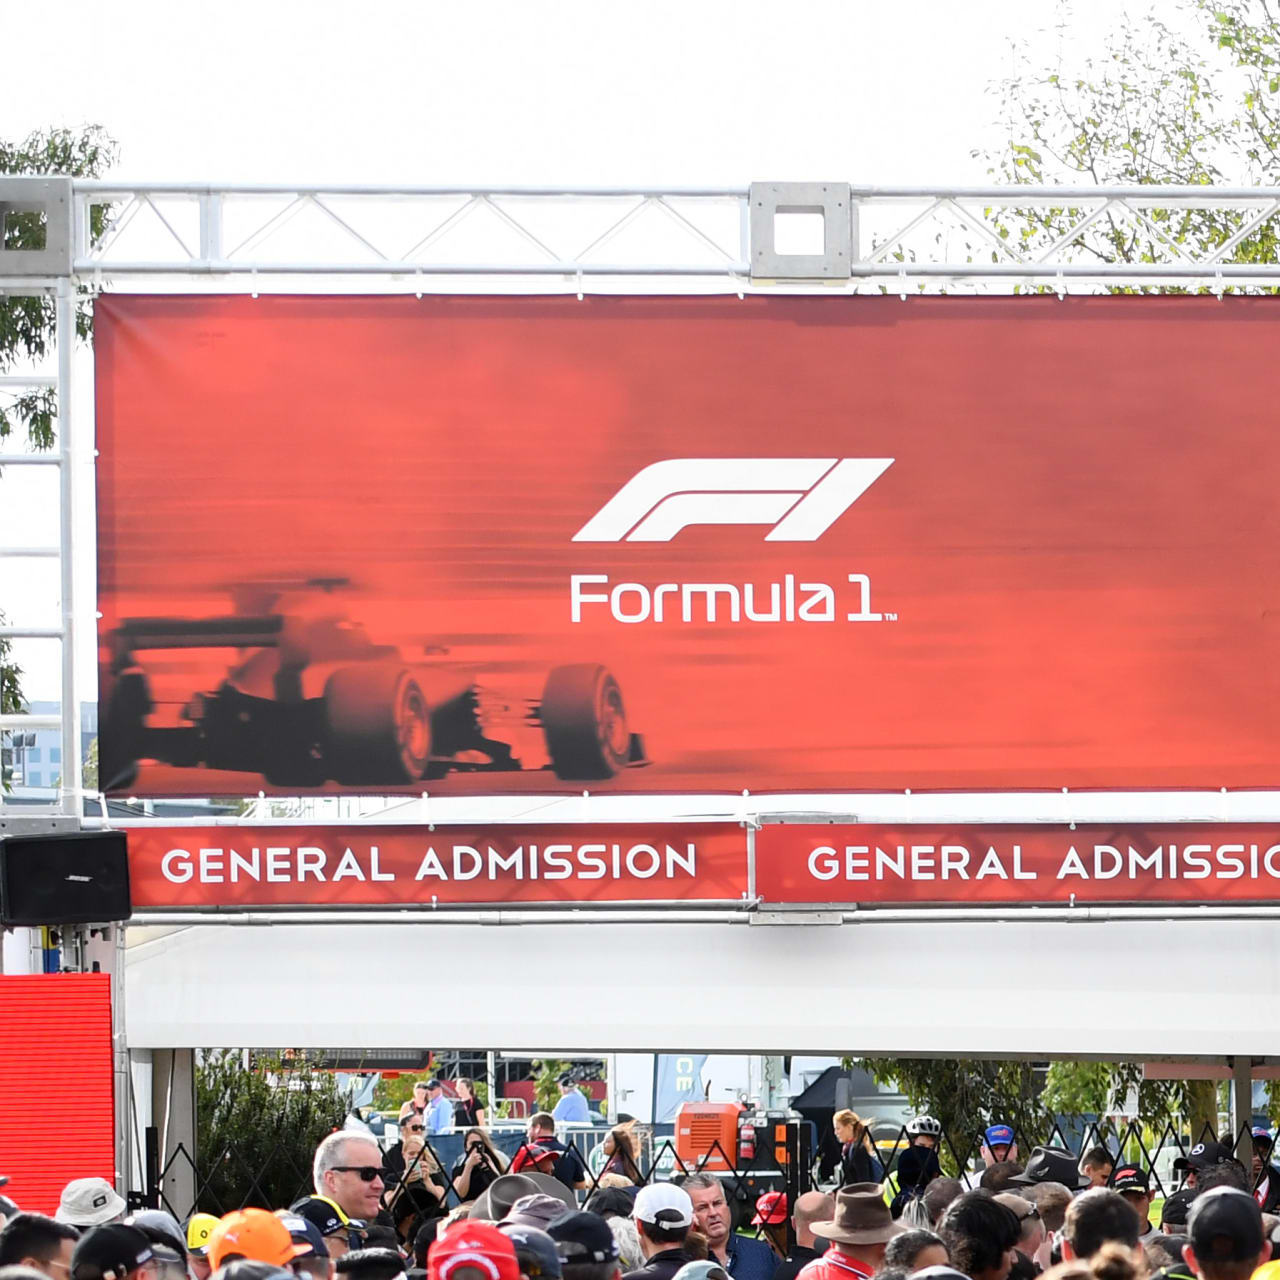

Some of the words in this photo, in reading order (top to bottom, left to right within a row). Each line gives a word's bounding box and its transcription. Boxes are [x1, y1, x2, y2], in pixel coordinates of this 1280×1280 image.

[163, 847, 395, 884] GENERAL
[415, 845, 697, 882] ADMISSION
[808, 846, 1038, 882] GENERAL
